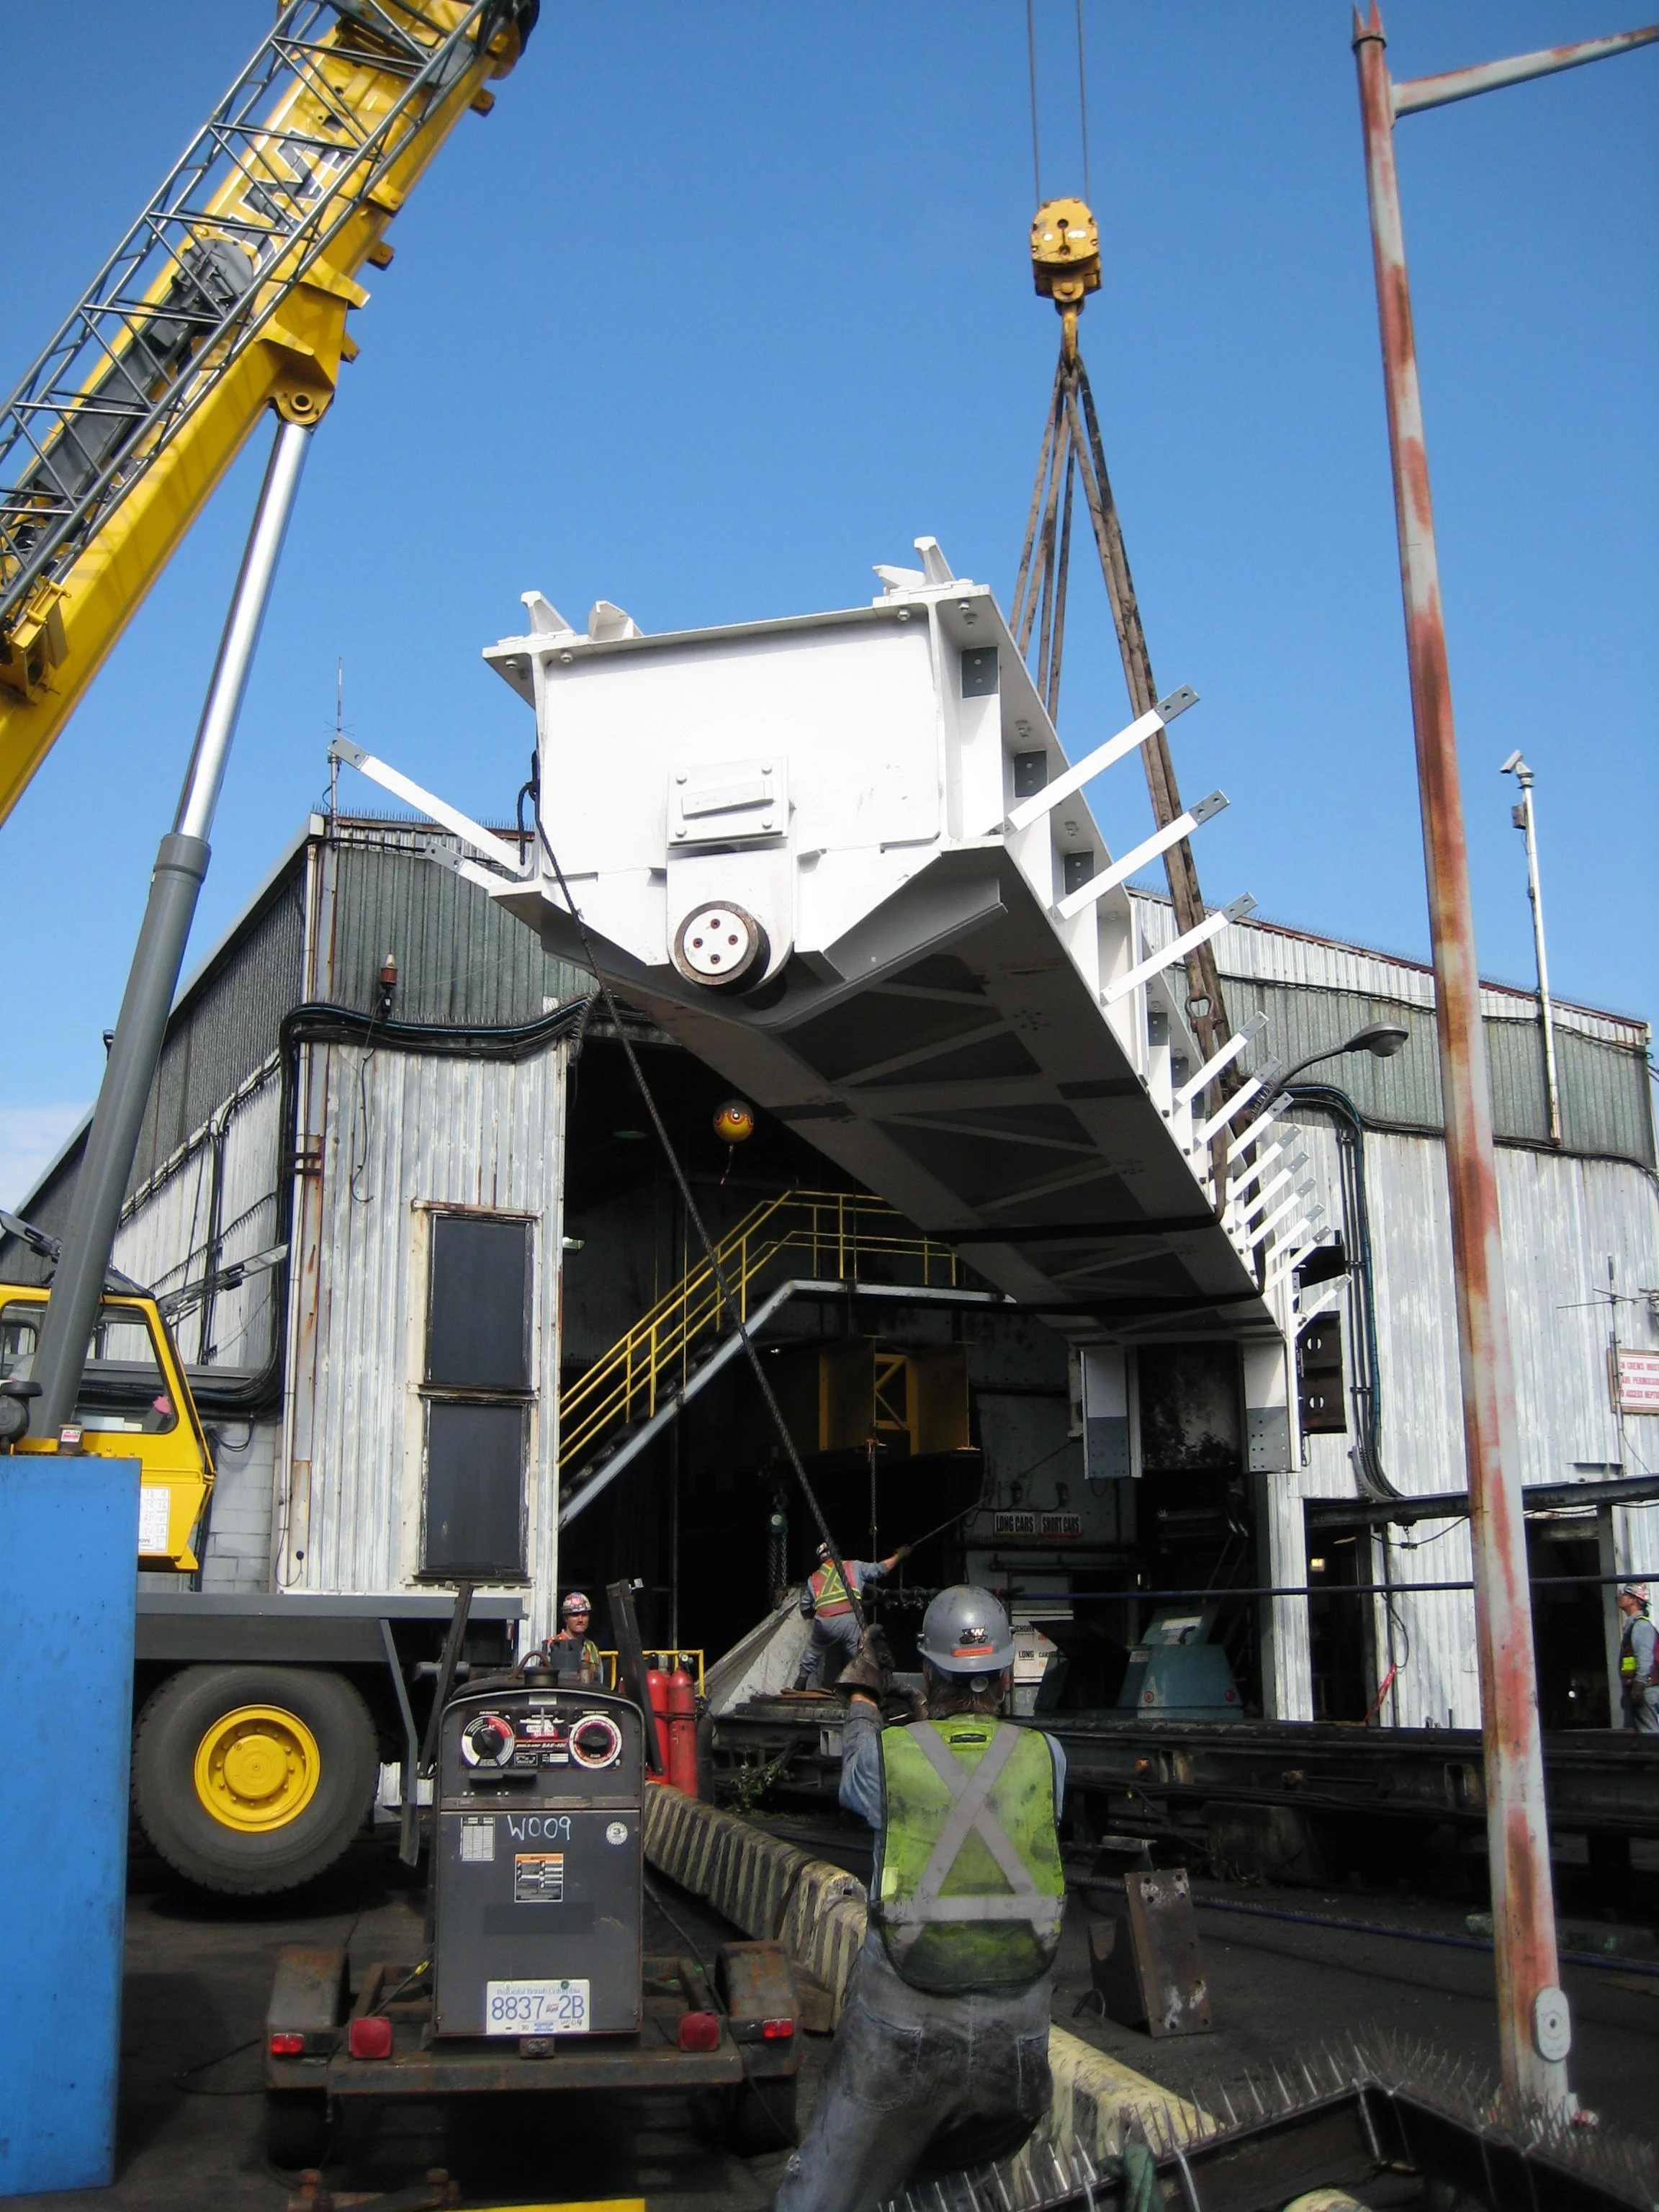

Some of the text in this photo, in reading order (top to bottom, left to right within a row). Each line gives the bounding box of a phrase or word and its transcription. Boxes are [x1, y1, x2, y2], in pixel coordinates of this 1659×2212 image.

[996, 1515, 1034, 1532] LONG CARS
[1042, 1516, 1079, 1533] SHORT CARS
[507, 1815, 571, 1841] W009
[492, 1995, 585, 2020] 8837 2B
